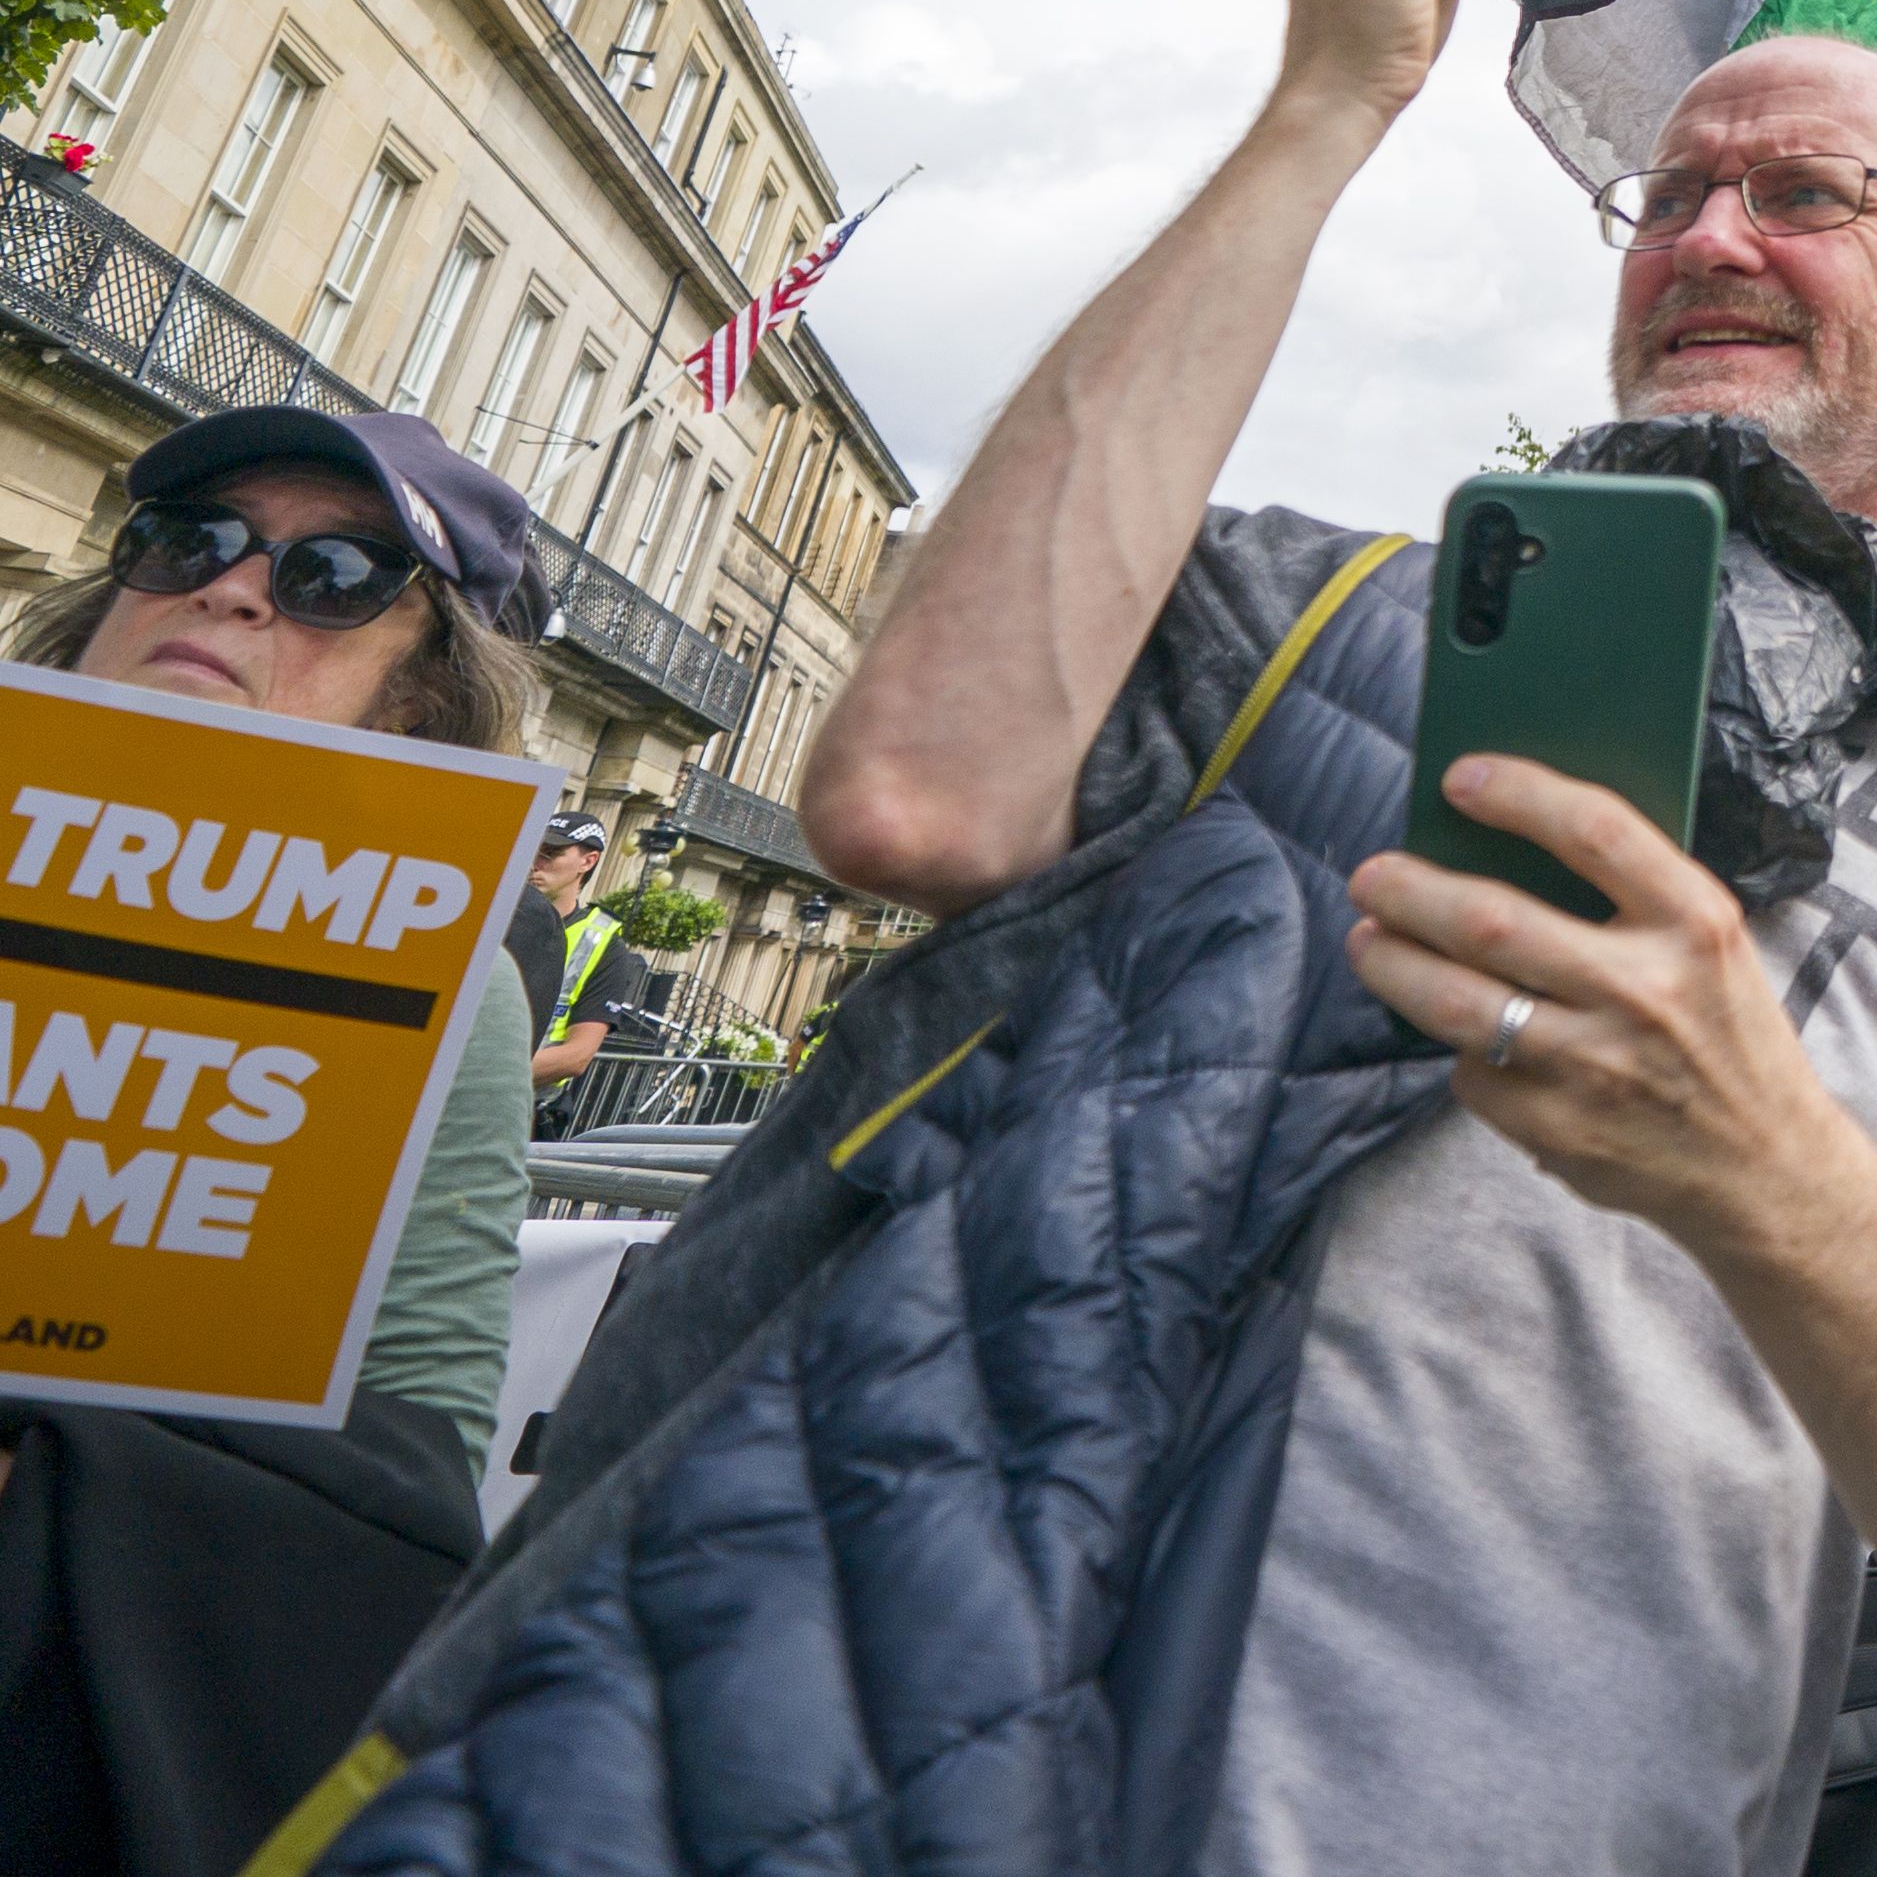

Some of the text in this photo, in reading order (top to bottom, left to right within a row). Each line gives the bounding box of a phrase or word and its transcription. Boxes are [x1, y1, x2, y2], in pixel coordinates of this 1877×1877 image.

[6, 785, 472, 953] TRUMP
[0, 998, 322, 1146] NTS
[0, 1315, 108, 1353] AND
